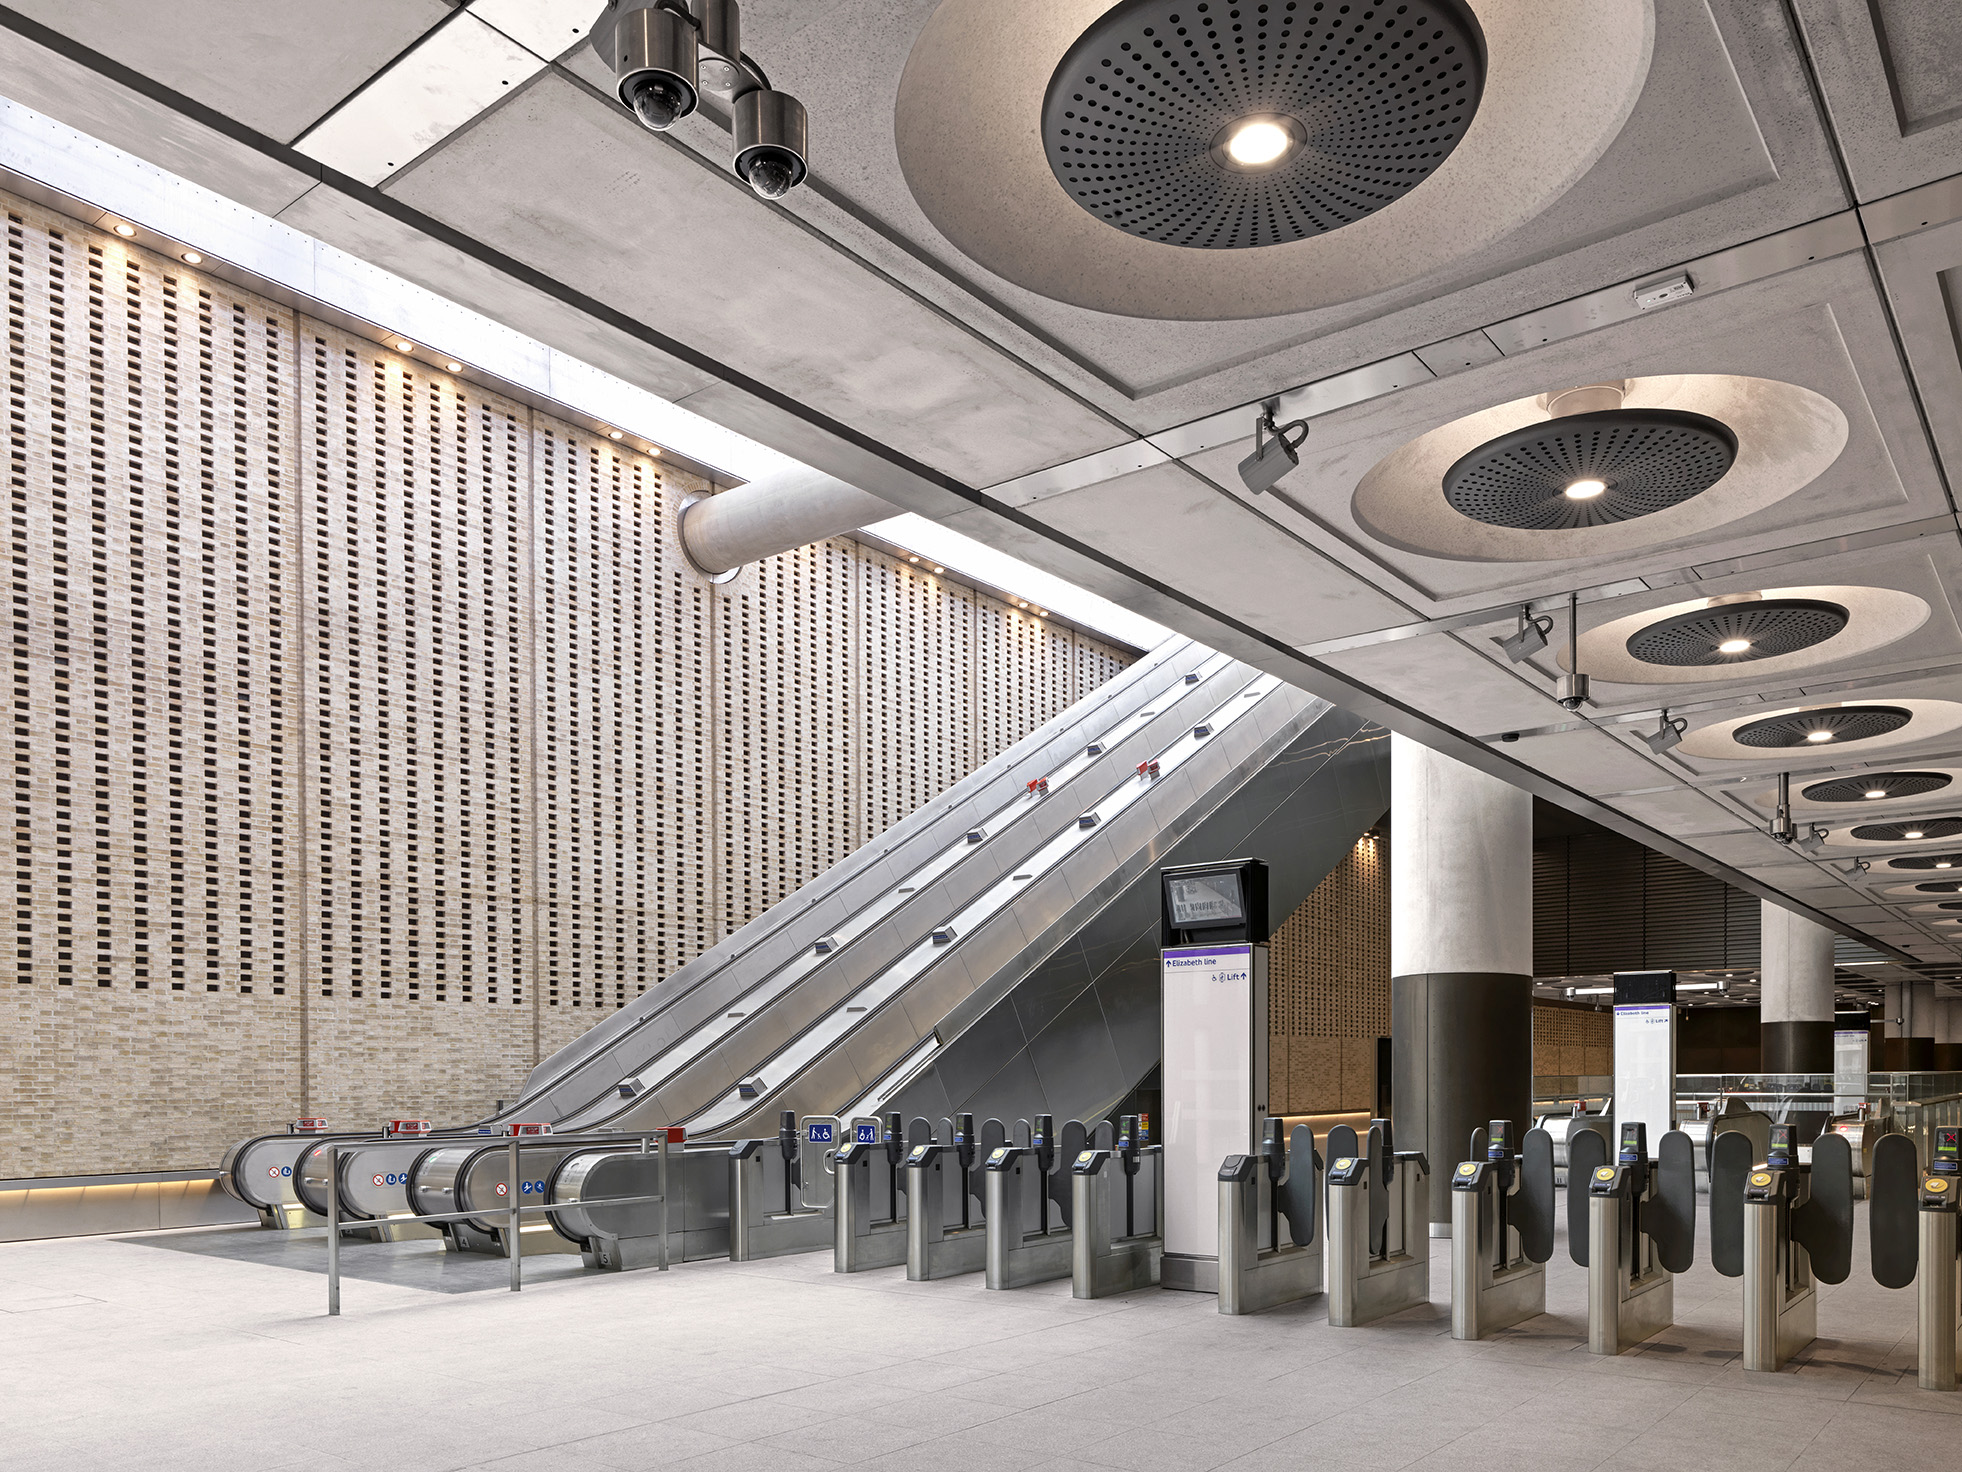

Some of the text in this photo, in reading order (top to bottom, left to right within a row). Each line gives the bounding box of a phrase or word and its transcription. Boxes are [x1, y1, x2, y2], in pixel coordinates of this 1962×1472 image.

[1172, 958, 1217, 967] Elizabeth line
[1227, 973, 1240, 981] Lift
[461, 1238, 467, 1247] 4
[603, 1254, 609, 1264] 5
